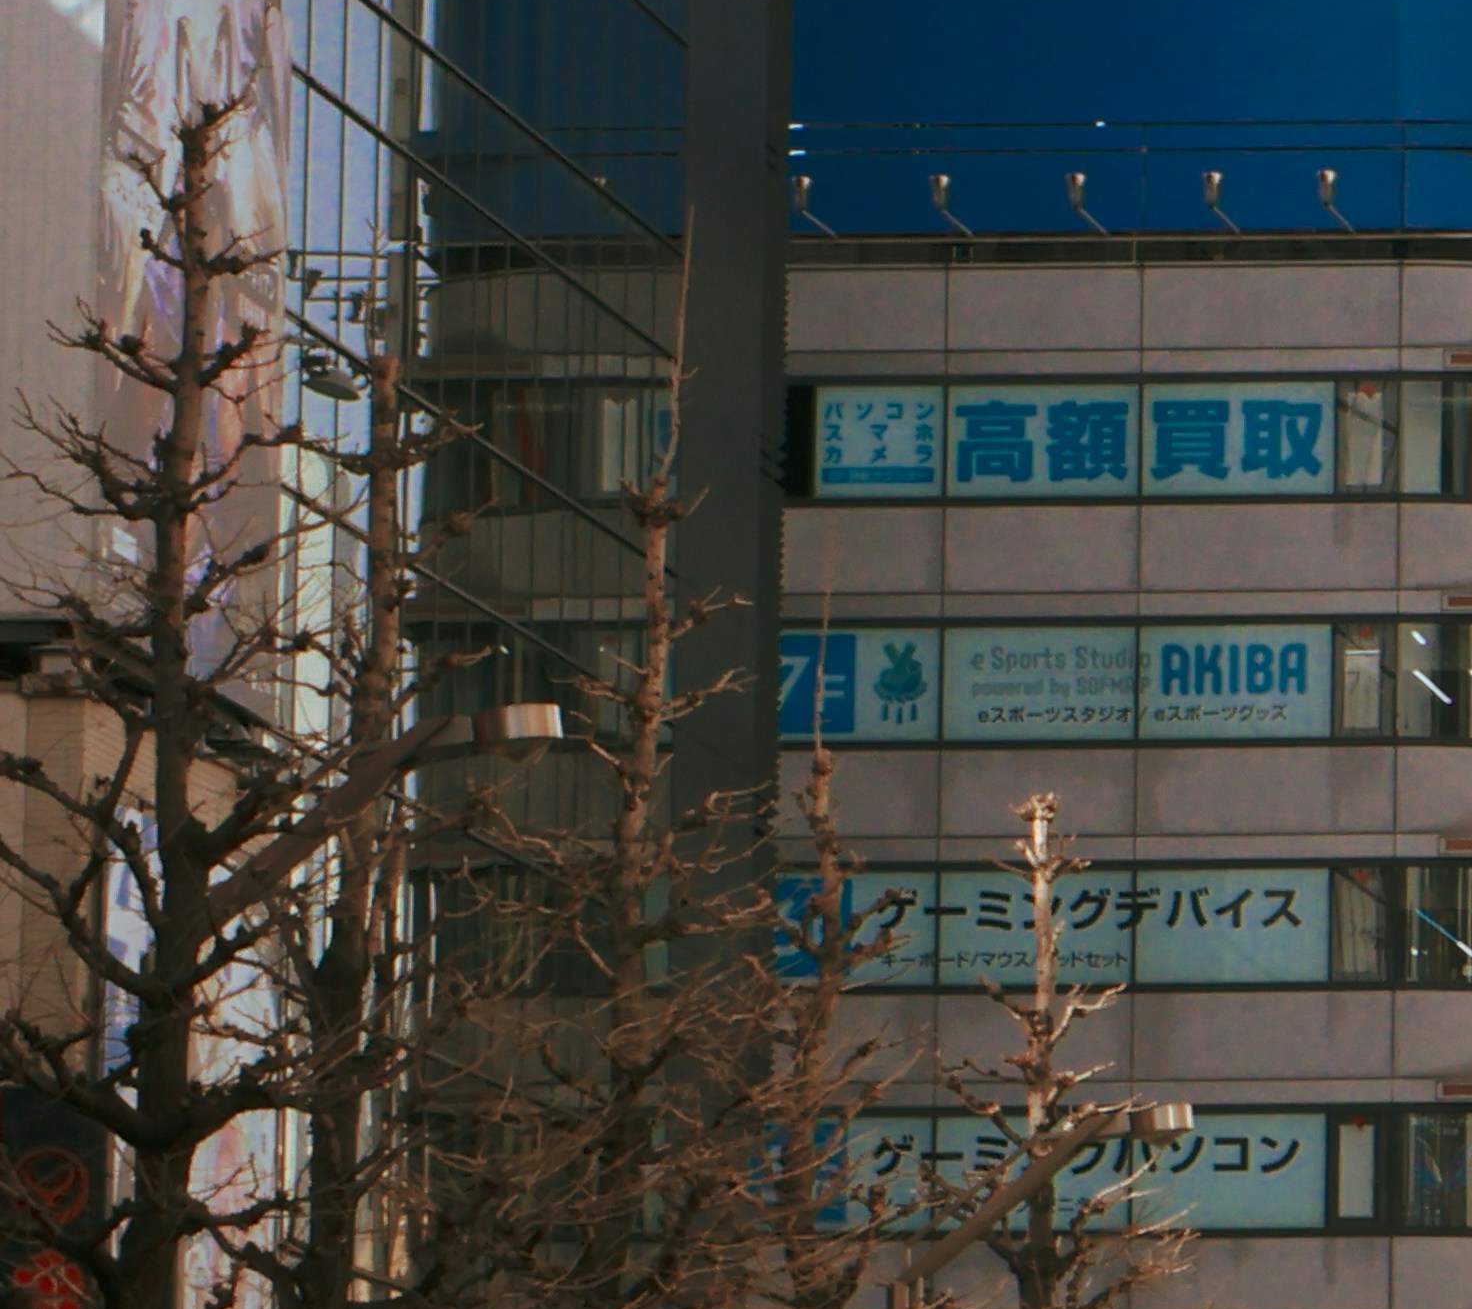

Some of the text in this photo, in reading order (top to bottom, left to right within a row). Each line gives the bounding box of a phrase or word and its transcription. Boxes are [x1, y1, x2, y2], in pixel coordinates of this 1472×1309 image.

[956, 401, 1322, 482] 高額買取
[1162, 644, 1308, 696] AKIBA
